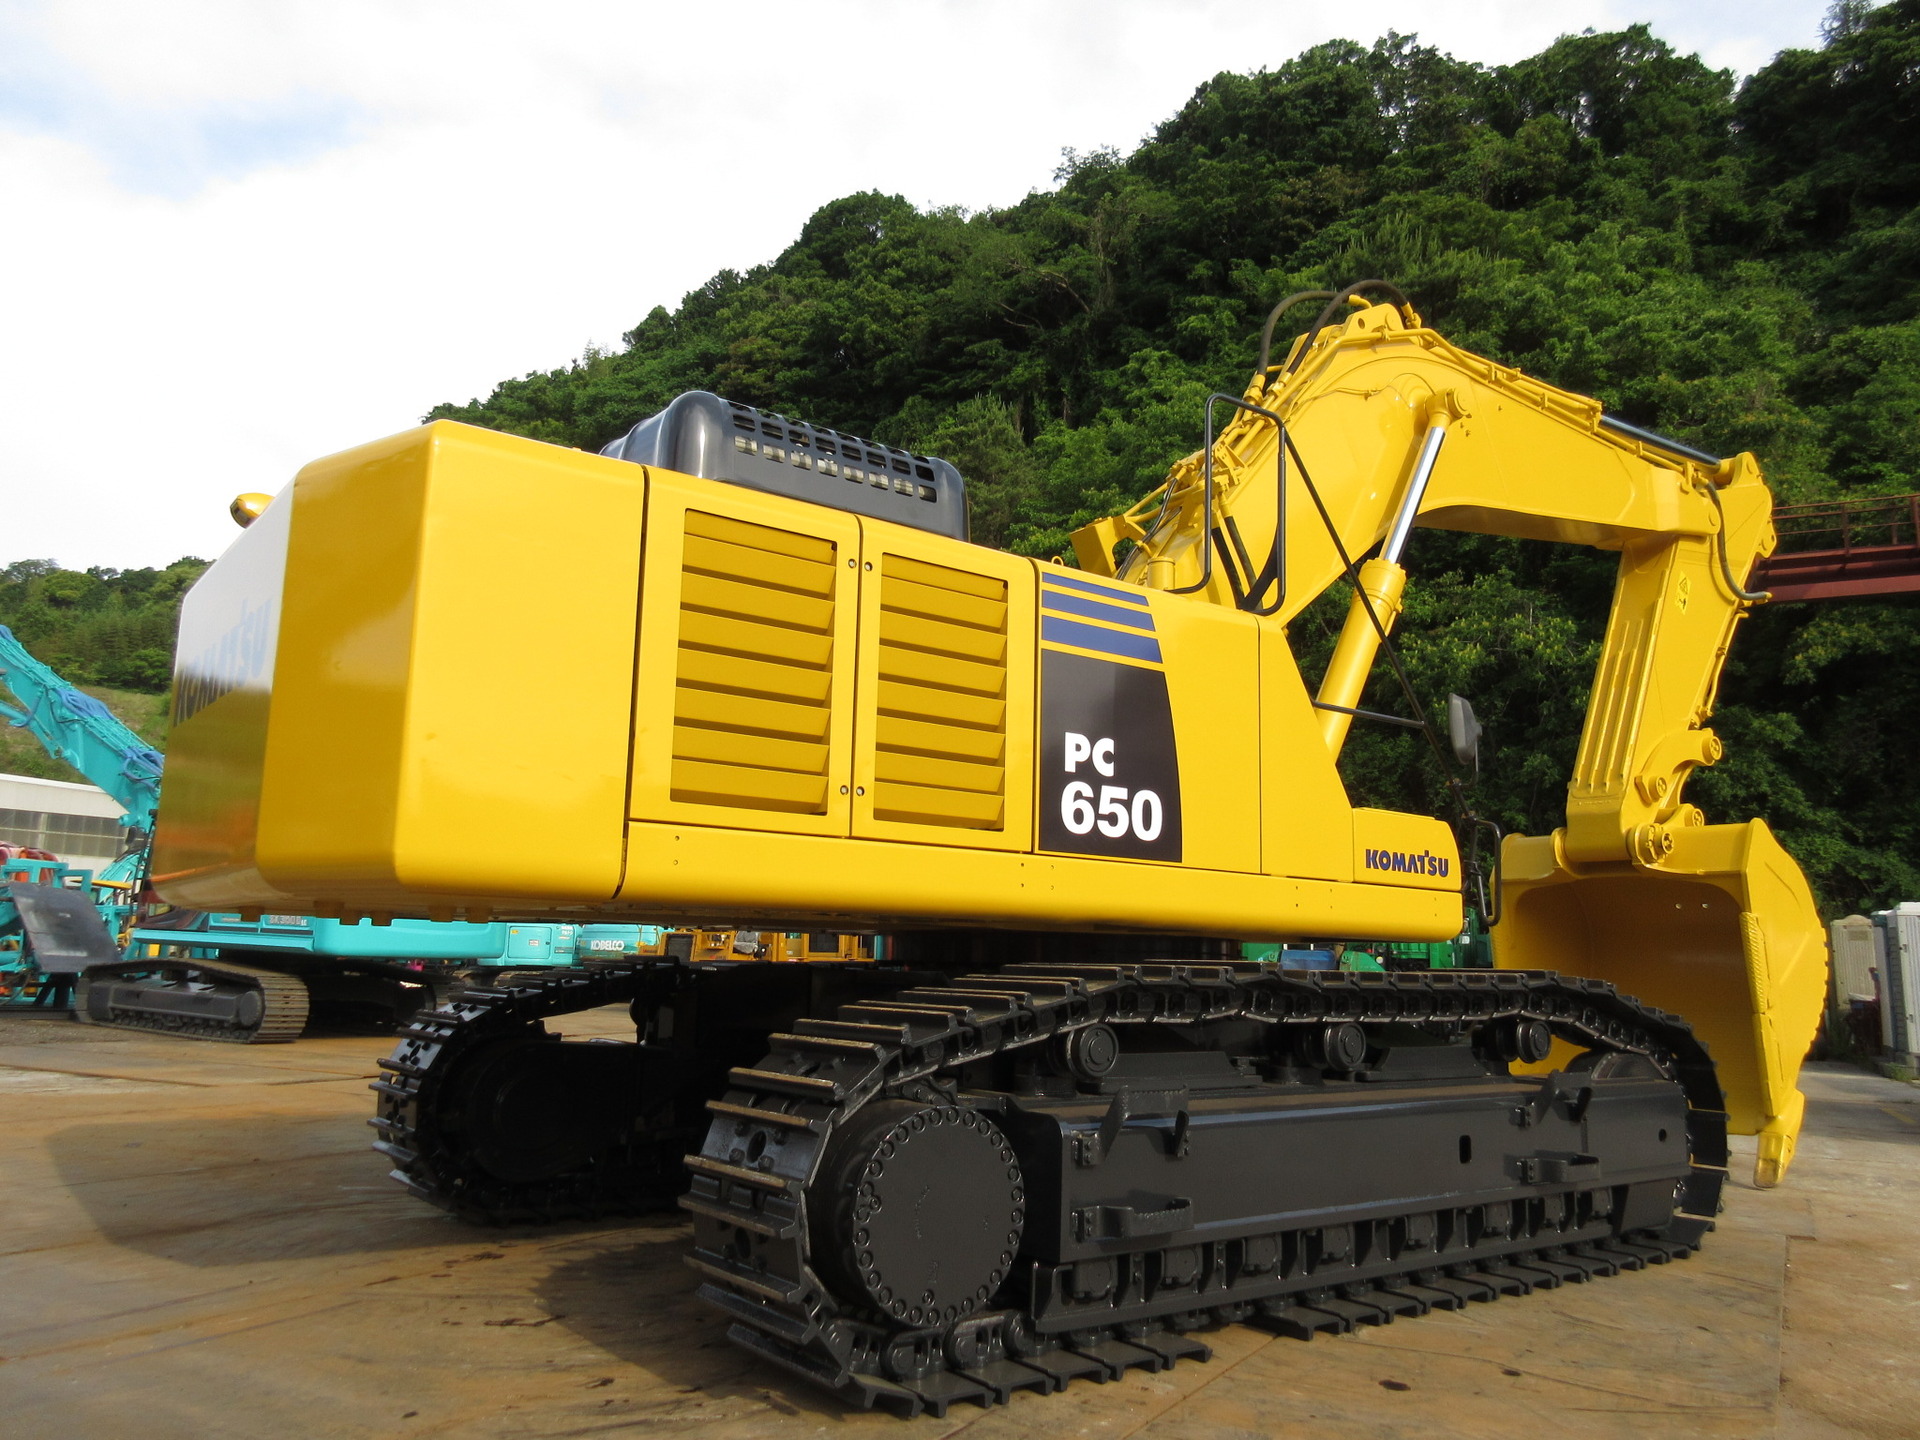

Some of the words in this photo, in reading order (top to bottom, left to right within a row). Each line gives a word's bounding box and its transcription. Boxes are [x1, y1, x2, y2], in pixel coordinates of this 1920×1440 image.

[1064, 731, 1115, 777] PC
[1061, 780, 1163, 842] 650
[1365, 848, 1449, 878] KOMATSU
[590, 940, 625, 951] KOBELCO
